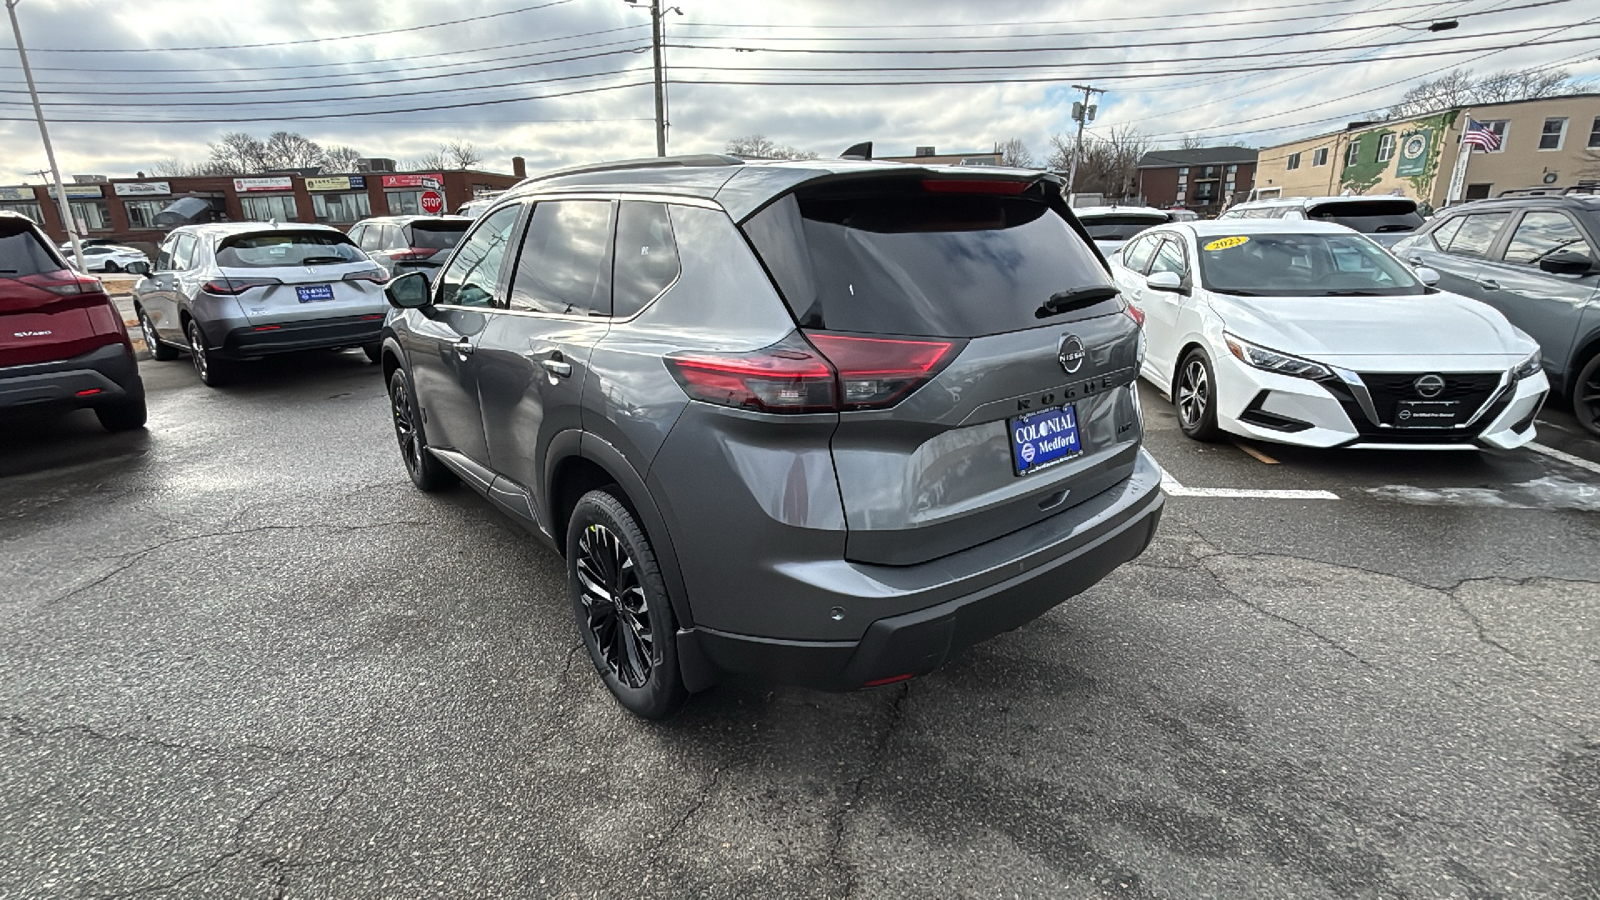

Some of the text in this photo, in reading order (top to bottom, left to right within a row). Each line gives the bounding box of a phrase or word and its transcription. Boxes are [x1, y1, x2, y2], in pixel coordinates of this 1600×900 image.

[422, 197, 441, 207] STOP
[1213, 237, 1242, 249] 2023
[1060, 351, 1085, 361] NISSAN
[1017, 375, 1113, 411] ROGUE
[1016, 413, 1076, 444] COLONIAL
[1039, 432, 1076, 454] Medford
